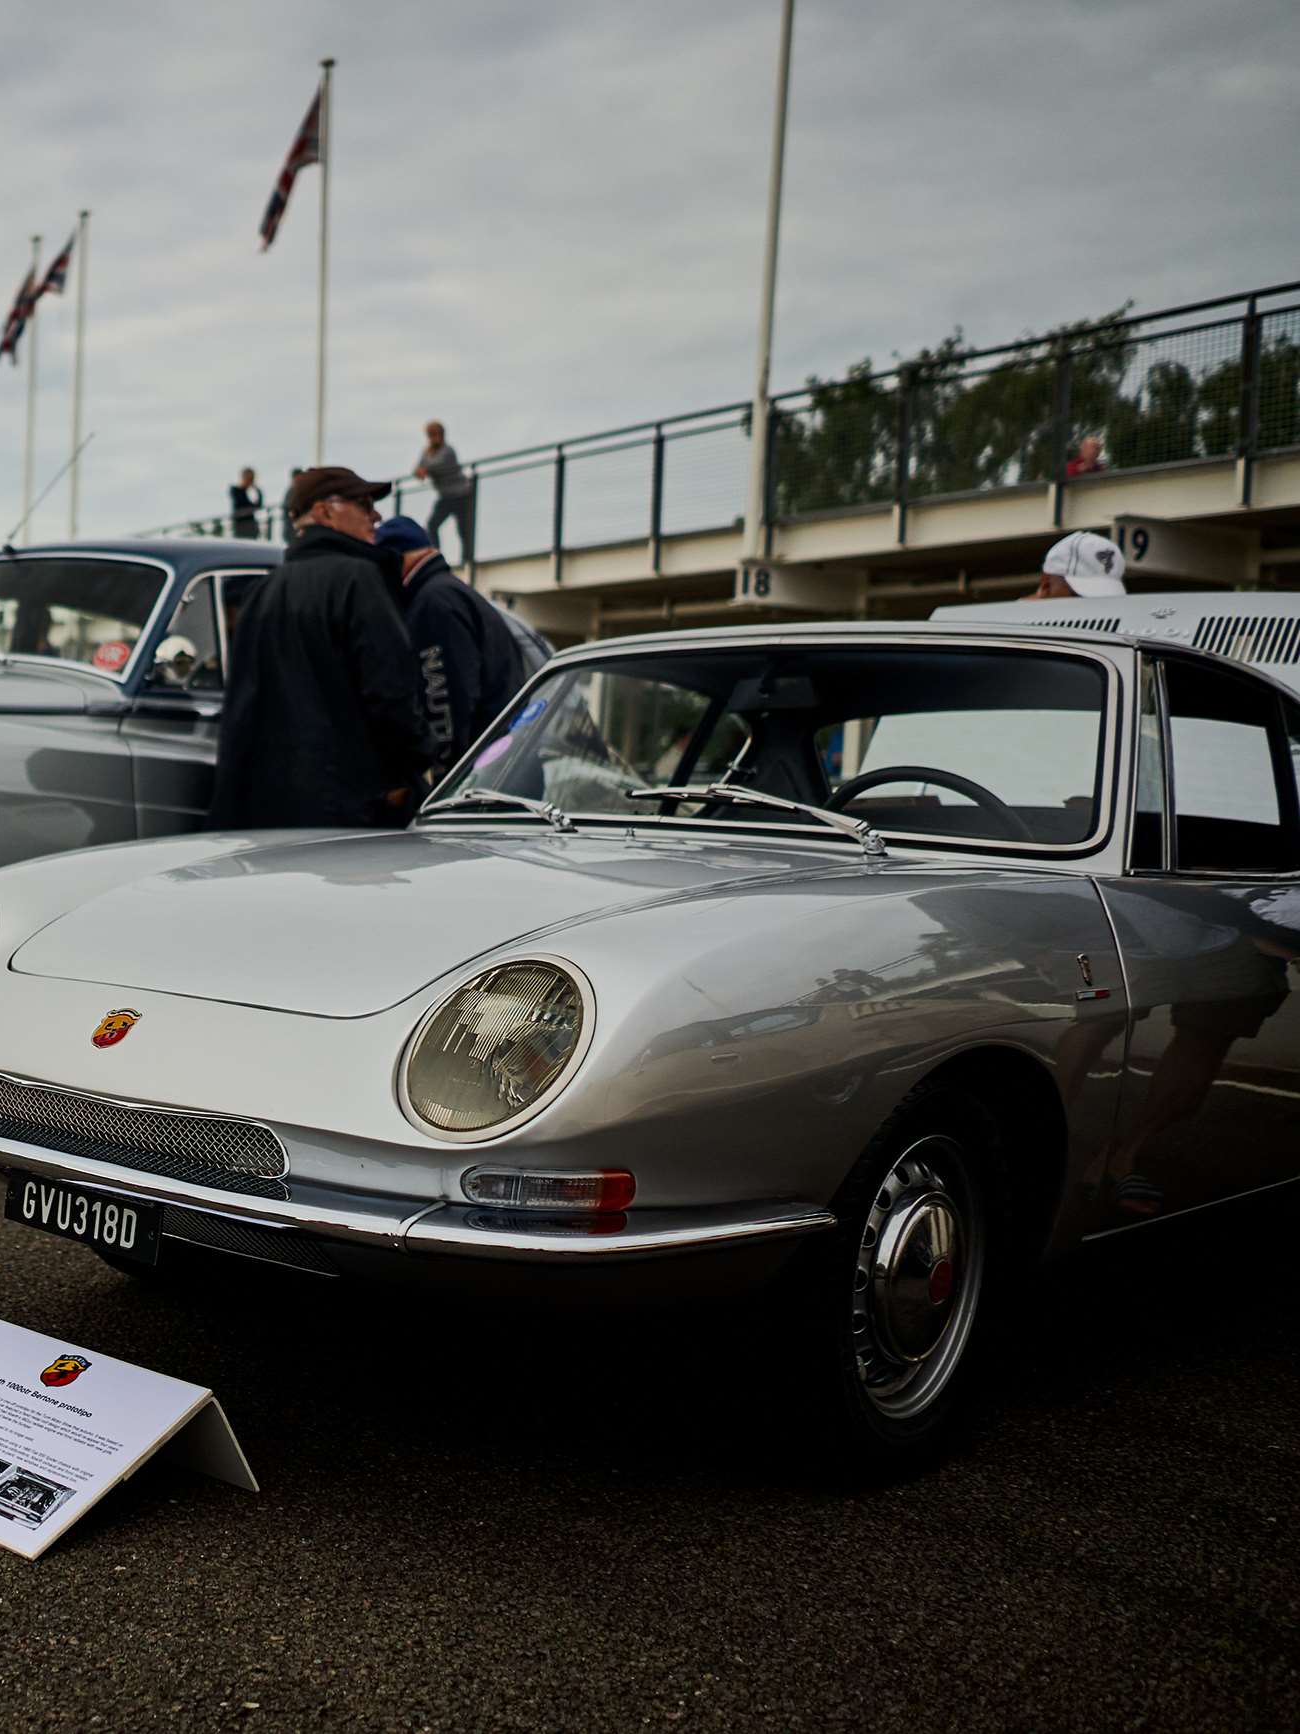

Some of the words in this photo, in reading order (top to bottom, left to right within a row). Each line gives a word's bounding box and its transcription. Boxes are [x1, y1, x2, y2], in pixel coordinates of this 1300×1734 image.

[22, 1181, 137, 1249] GVU318D
[30, 1390, 60, 1405] Bertone
[57, 1401, 93, 1418] prototipo
